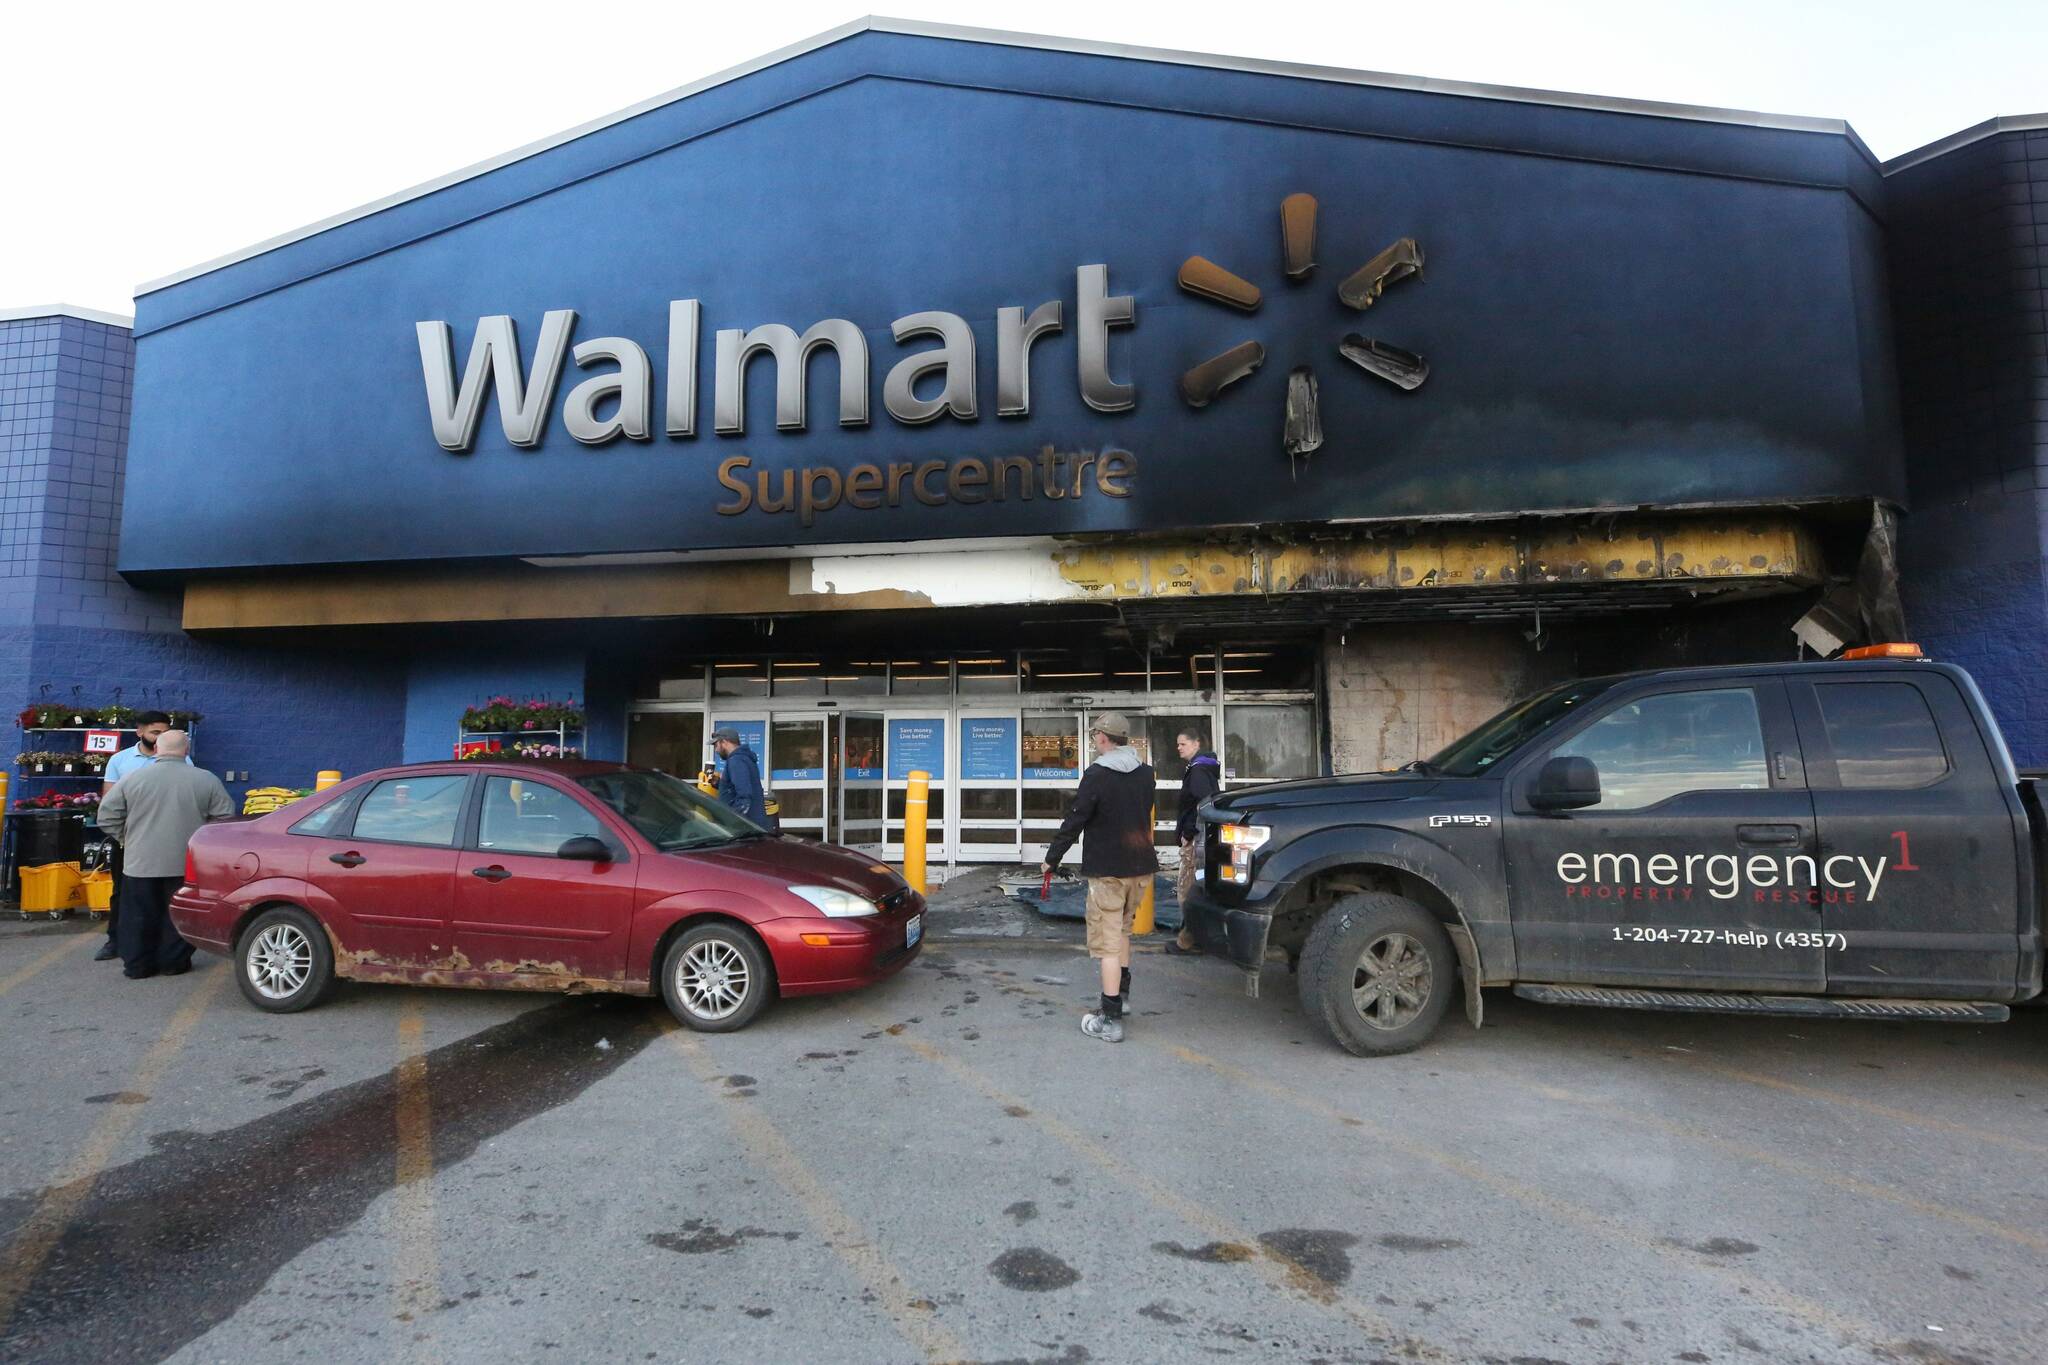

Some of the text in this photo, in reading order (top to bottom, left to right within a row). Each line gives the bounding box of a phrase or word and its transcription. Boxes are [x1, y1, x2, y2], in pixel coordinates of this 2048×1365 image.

[415, 264, 1135, 452] Walmart
[716, 445, 1138, 528] Supercentre
[793, 769, 807, 777] Exit
[858, 768, 870, 777] Exit
[1034, 768, 1072, 777] Welcome
[1557, 852, 1887, 901] emergency
[1565, 885, 1856, 904] PROPERTY RESCUE
[1612, 926, 1847, 951] 1-204-727-help (4357)
